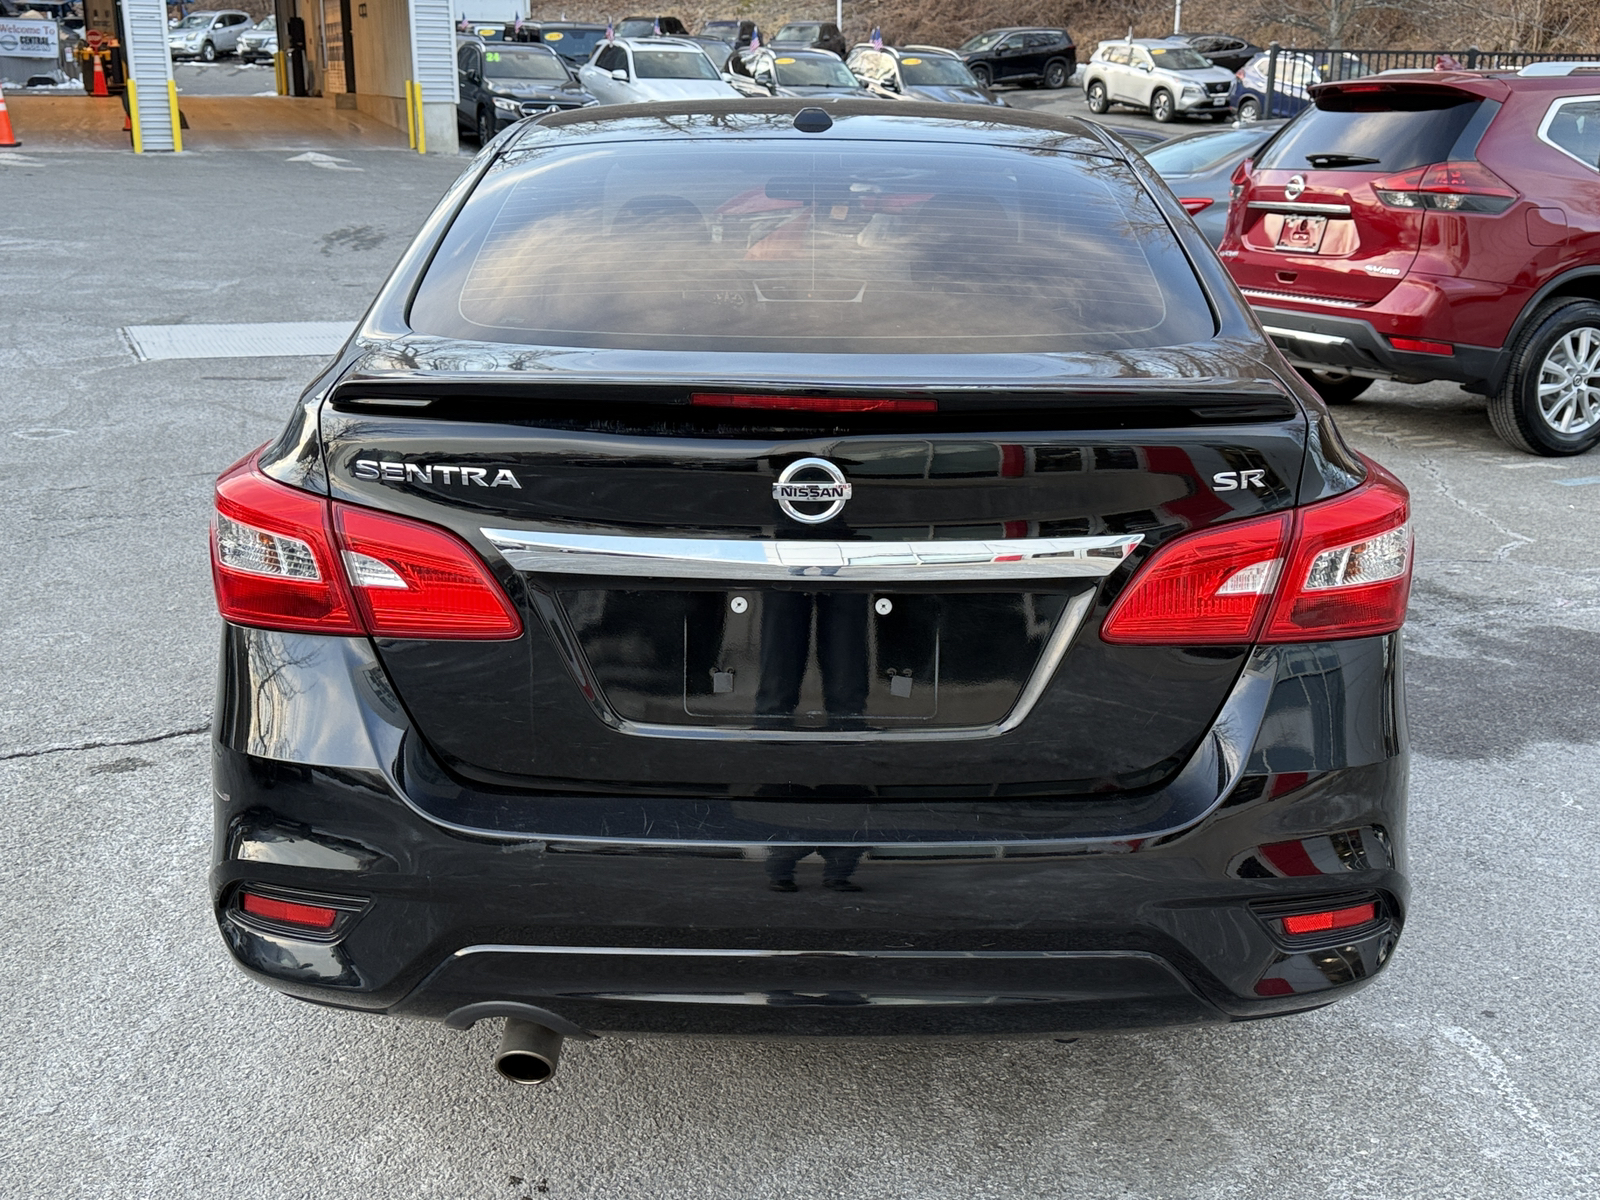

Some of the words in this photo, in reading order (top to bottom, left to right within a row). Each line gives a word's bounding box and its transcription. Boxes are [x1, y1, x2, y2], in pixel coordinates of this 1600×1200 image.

[0, 24, 40, 34] Welcome
[42, 26, 55, 35] To
[20, 36, 49, 45] CENTRAL
[486, 52, 500, 62] 24
[355, 459, 522, 489] SENTRA
[1212, 469, 1266, 491] SR
[781, 487, 843, 497] NISSAN
